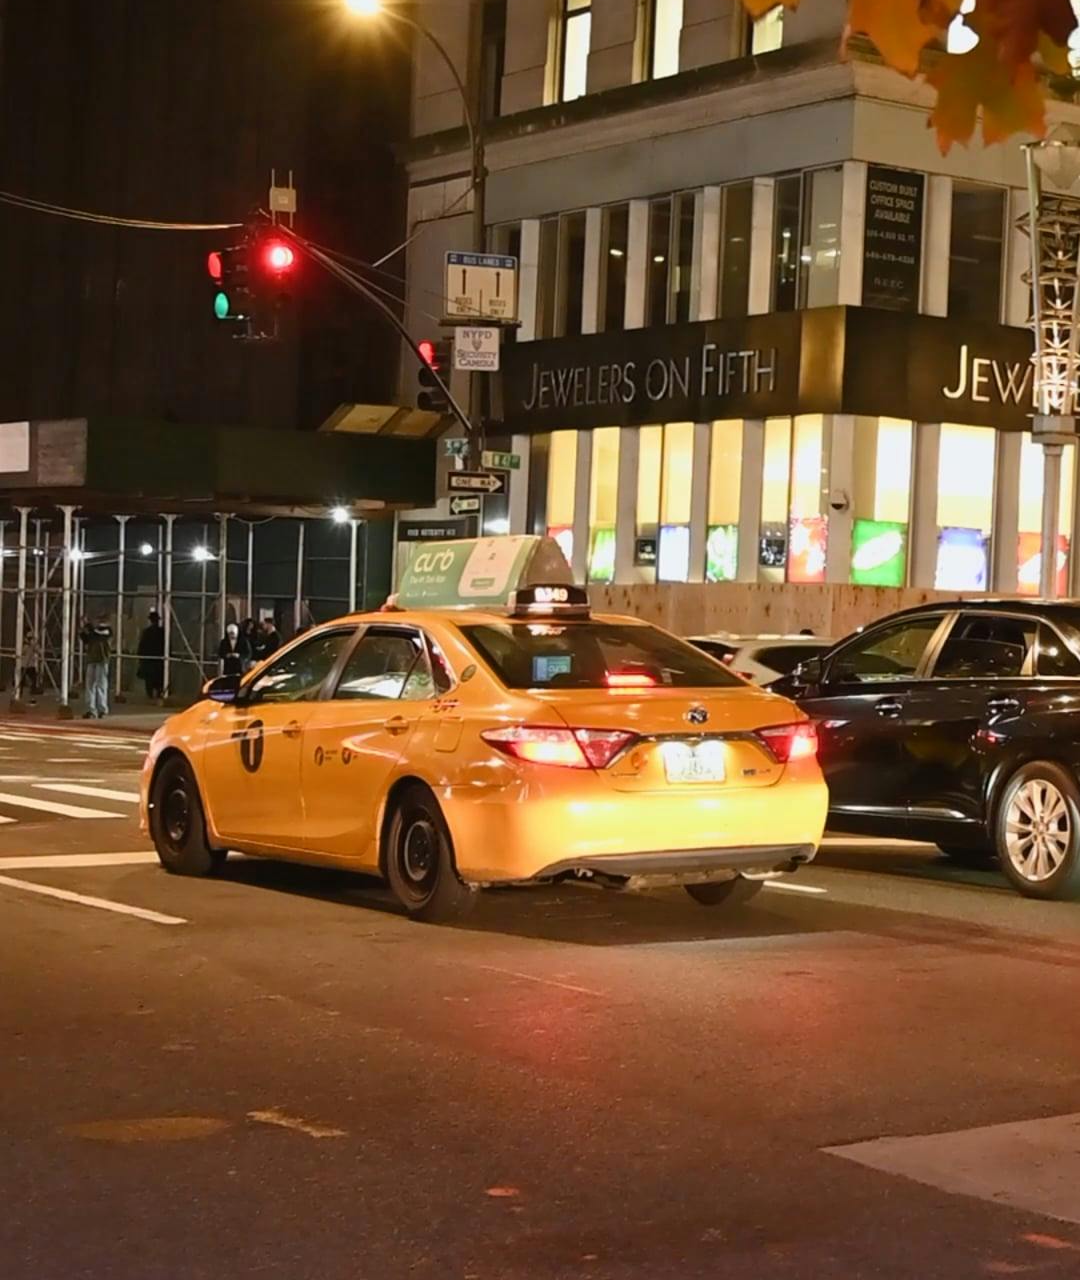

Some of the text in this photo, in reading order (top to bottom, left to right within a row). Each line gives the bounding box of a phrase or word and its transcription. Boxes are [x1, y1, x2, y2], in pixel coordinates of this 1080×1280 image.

[870, 180, 918, 198] CUSTOM BUILT
[870, 194, 915, 211] OFFICE SPACE
[875, 209, 911, 223] AVAILABLE
[463, 256, 500, 266] BUS LANES
[462, 330, 493, 339] NYPD
[456, 349, 497, 360] SECURITY
[458, 358, 496, 368] CAMERA
[522, 343, 777, 411] JEWELERS ON FIFTH
[455, 477, 497, 488] ONE WAY
[414, 548, 455, 573] curb
